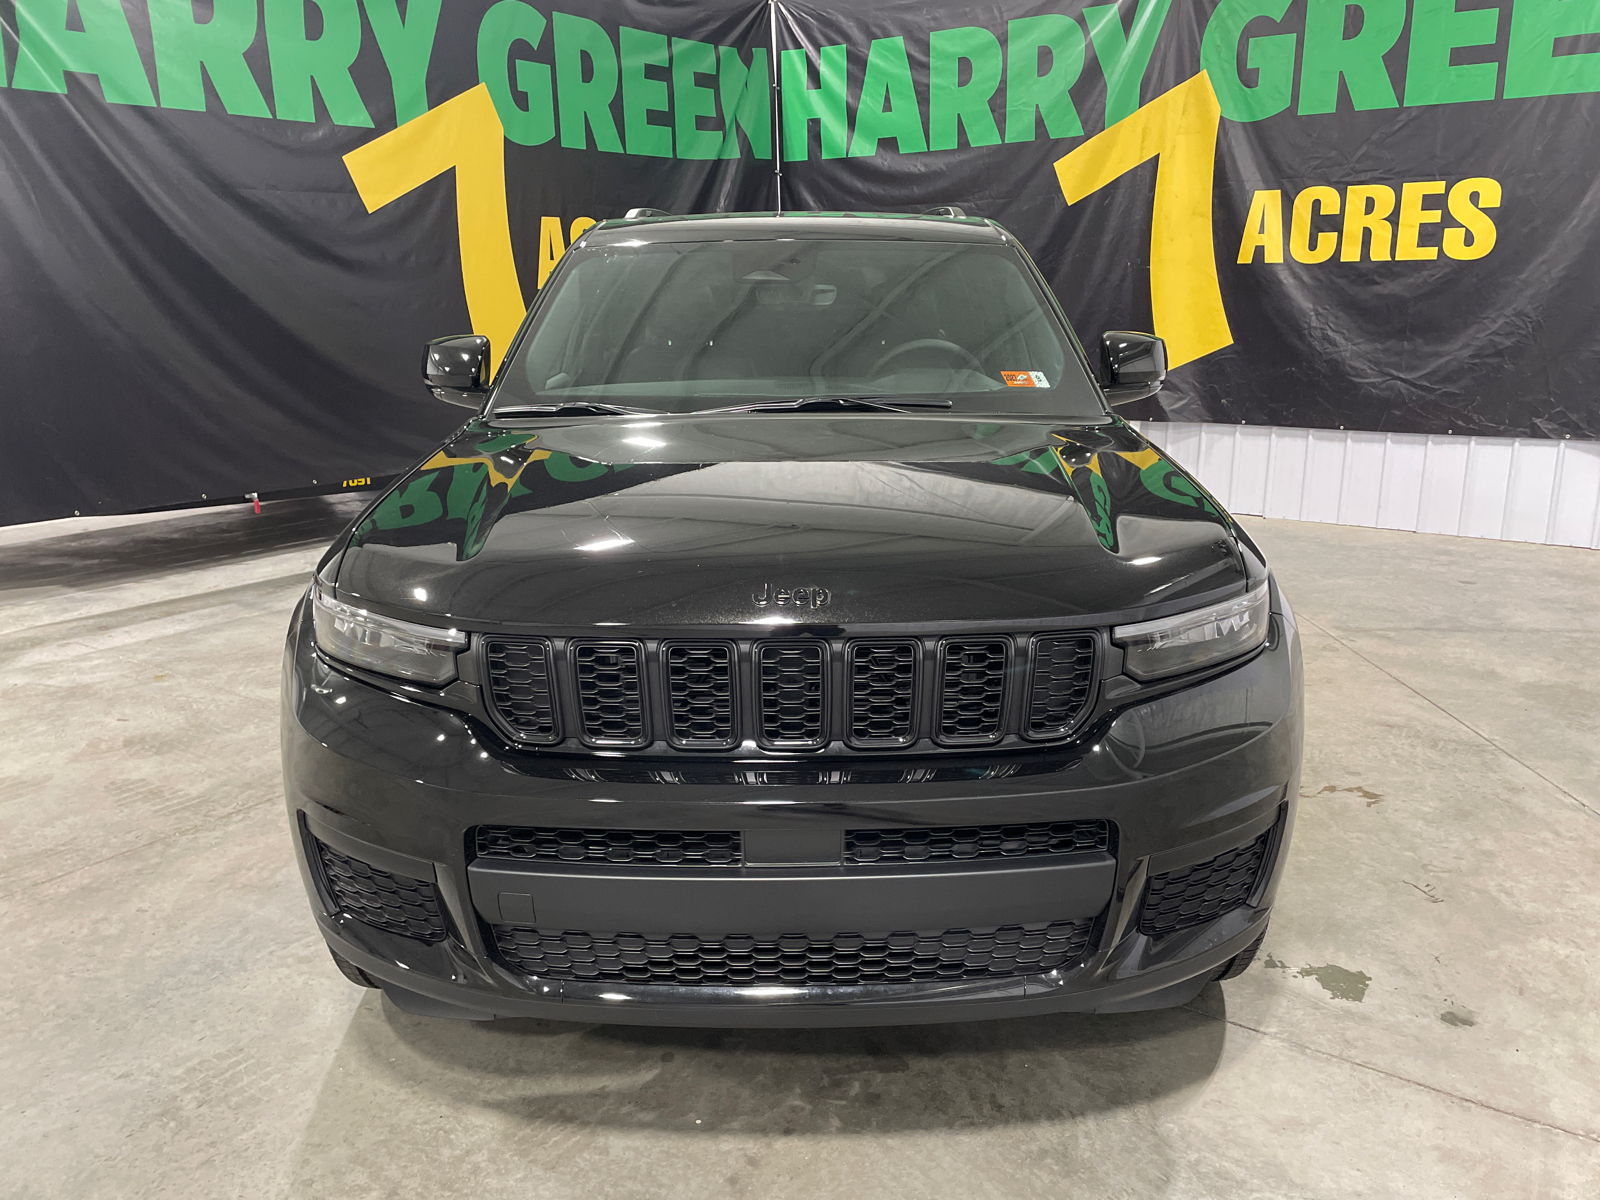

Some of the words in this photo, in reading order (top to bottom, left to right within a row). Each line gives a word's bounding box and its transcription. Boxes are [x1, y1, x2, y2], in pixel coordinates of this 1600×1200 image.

[0, 0, 440, 128] ARRY
[477, 1, 772, 160] GREEN
[781, 0, 1168, 161] HARRY
[342, 82, 528, 386] 7
[1053, 69, 1234, 371] 7
[1237, 177, 1502, 264] ACRES
[751, 582, 832, 611] Jeep
